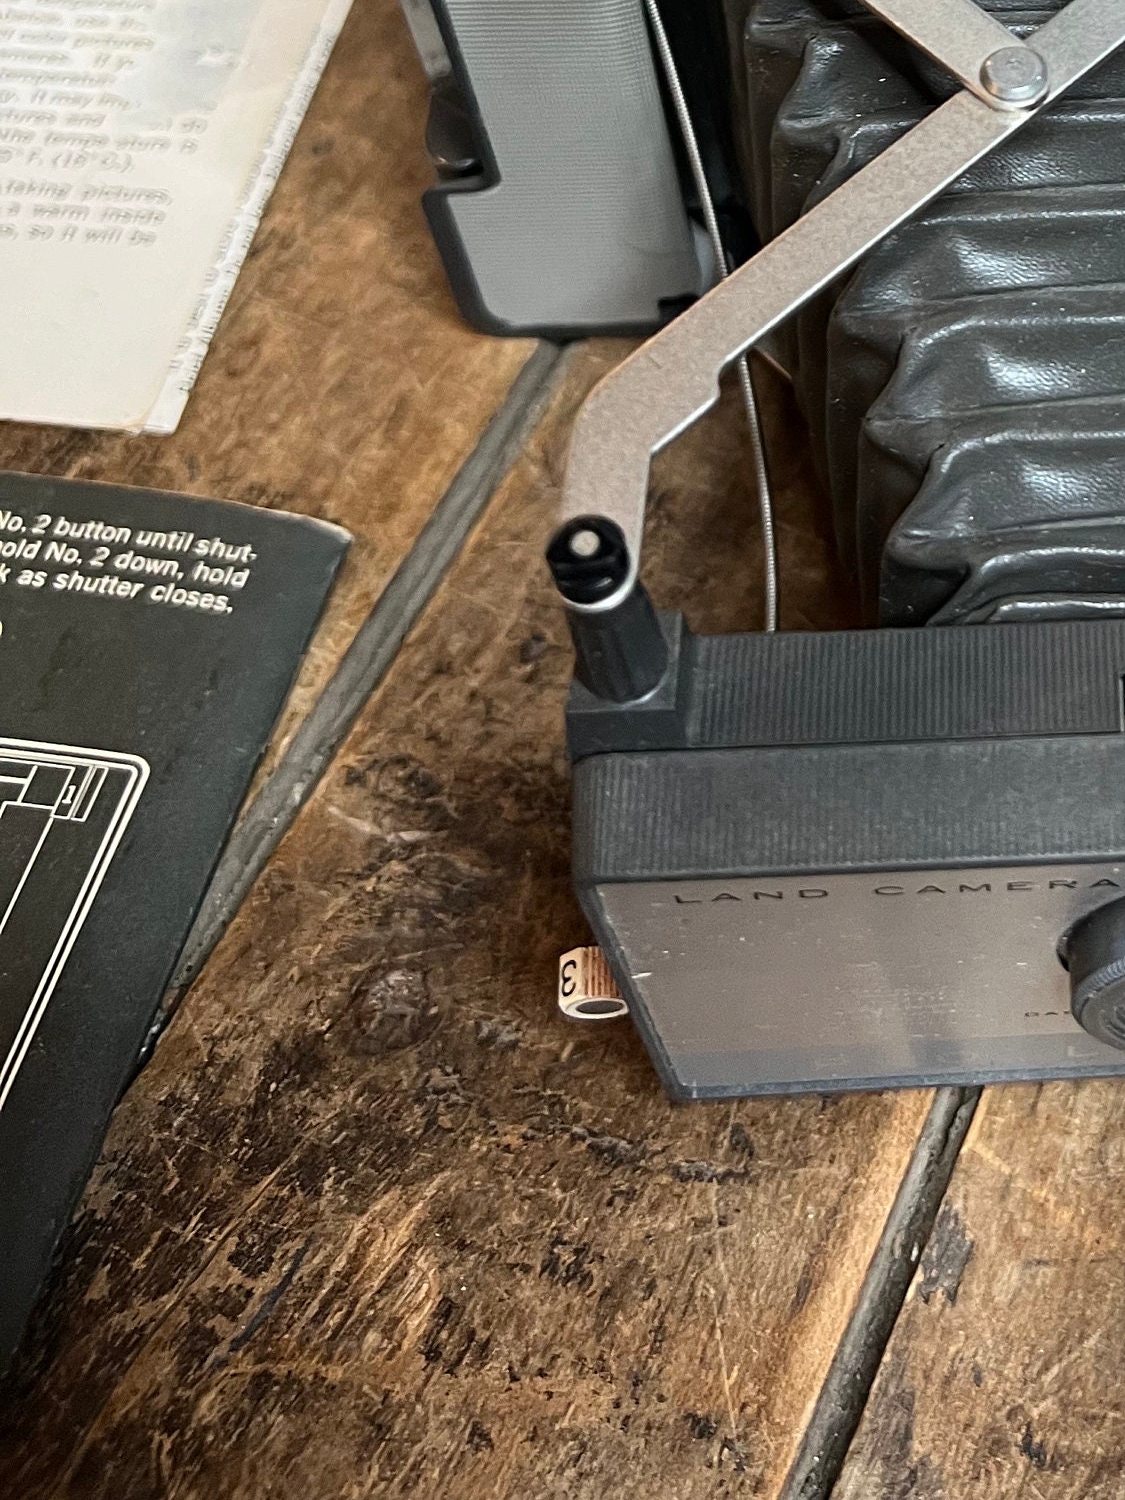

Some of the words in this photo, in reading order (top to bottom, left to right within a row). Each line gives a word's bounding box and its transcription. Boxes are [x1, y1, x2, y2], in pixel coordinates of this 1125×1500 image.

[31, 514, 52, 535] 2
[53, 517, 132, 544] button
[135, 529, 195, 553] until
[193, 537, 258, 564] shut-
[44, 541, 83, 566] No.
[89, 546, 111, 567] 2
[113, 550, 185, 581] down,
[192, 560, 251, 590] hold
[16, 568, 48, 588] as
[52, 570, 145, 599] shutter
[149, 582, 234, 615] closes.
[61, 784, 77, 805] 1
[673, 886, 830, 905] LAND
[873, 877, 1122, 896] CAMERA
[560, 958, 577, 997] 3
